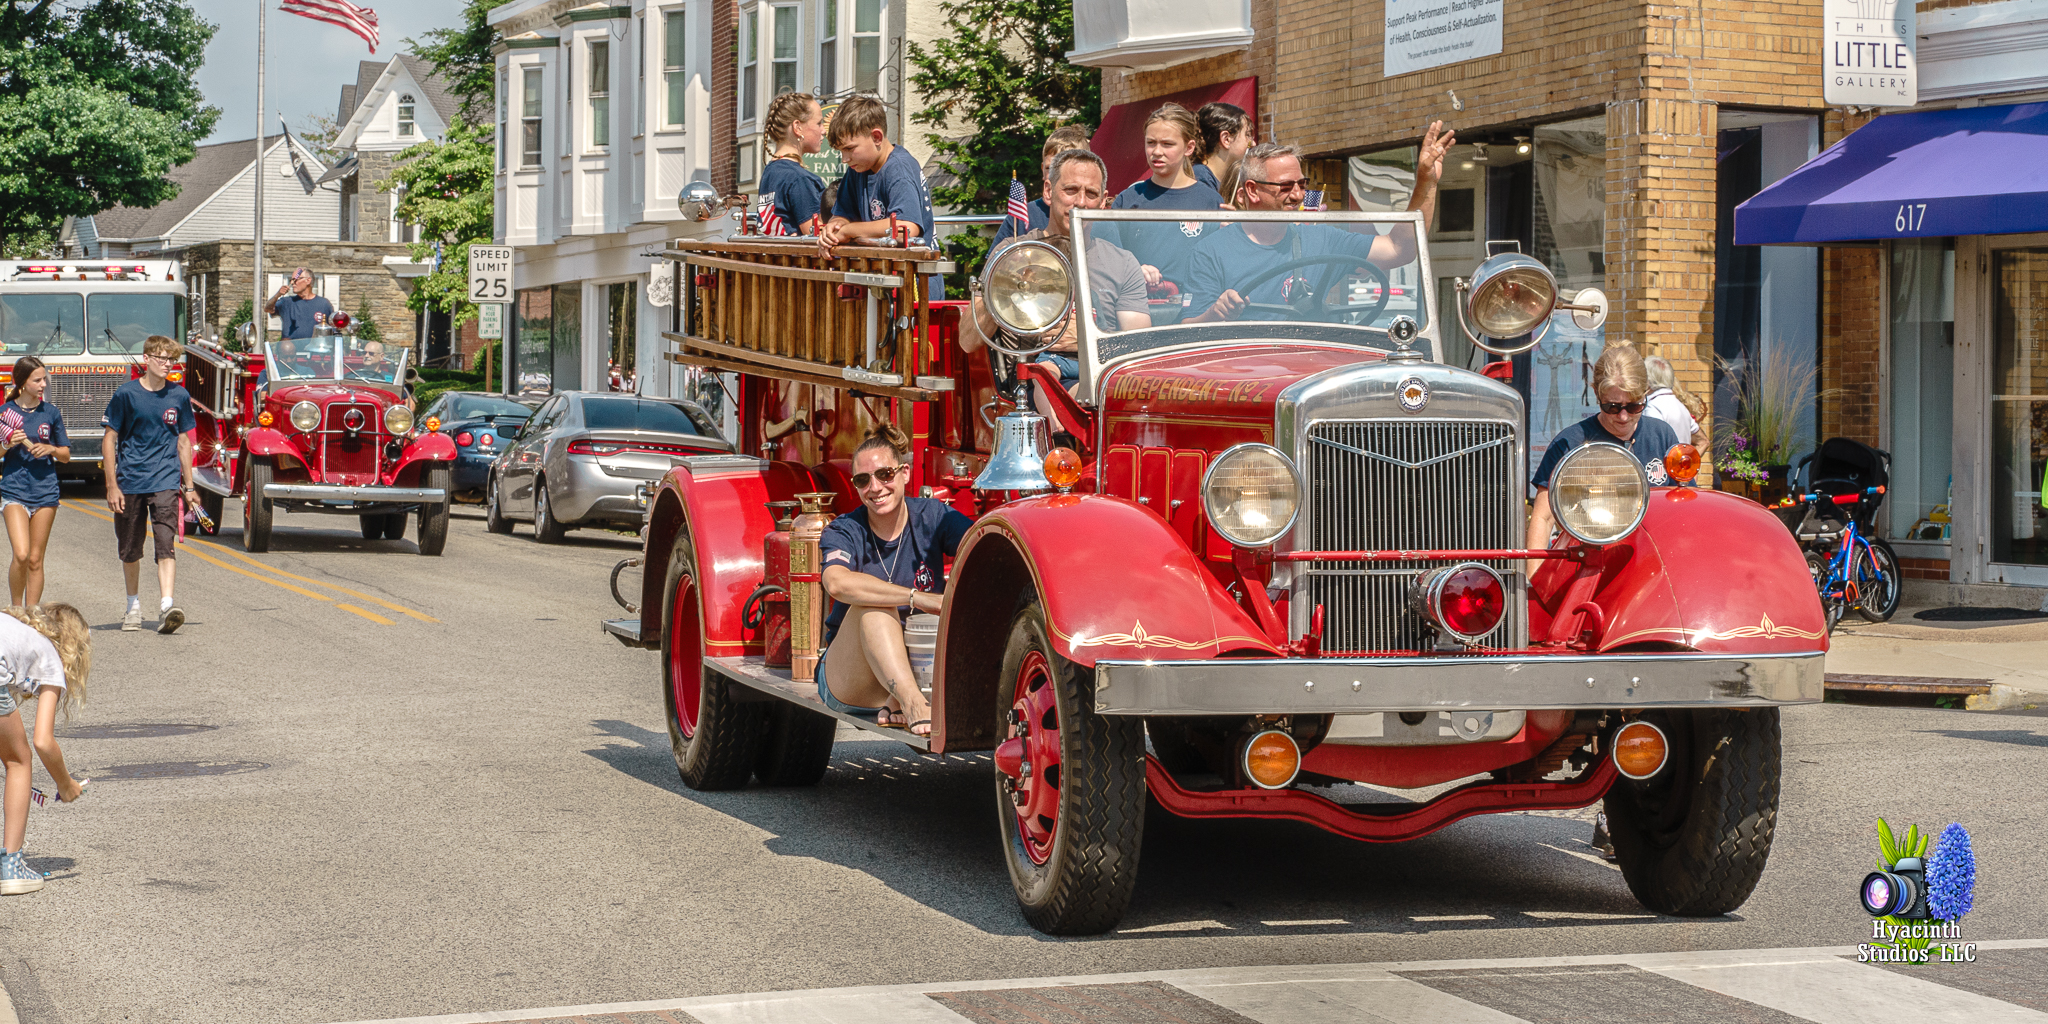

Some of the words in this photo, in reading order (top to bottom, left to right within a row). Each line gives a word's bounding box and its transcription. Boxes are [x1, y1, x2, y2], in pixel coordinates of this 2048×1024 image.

[1387, 15, 1405, 28] Support
[1406, 11, 1417, 23] Peak
[1418, 6, 1448, 20] Performance
[1452, 0, 1466, 12] Reach
[1412, 25, 1447, 40] Consciousness
[1835, 22, 1907, 35] THIS
[1835, 41, 1907, 69] LITTLE
[1835, 76, 1907, 88] GALLERY
[814, 162, 848, 174] FAMI
[1895, 203, 1927, 232] 617
[473, 249, 510, 259] SPEED
[476, 262, 508, 272] LIMIT
[474, 277, 507, 298] 25
[47, 365, 126, 375] JENKINTOWN
[1113, 374, 1228, 401] INDEPENDENT
[1252, 382, 1275, 403] 2
